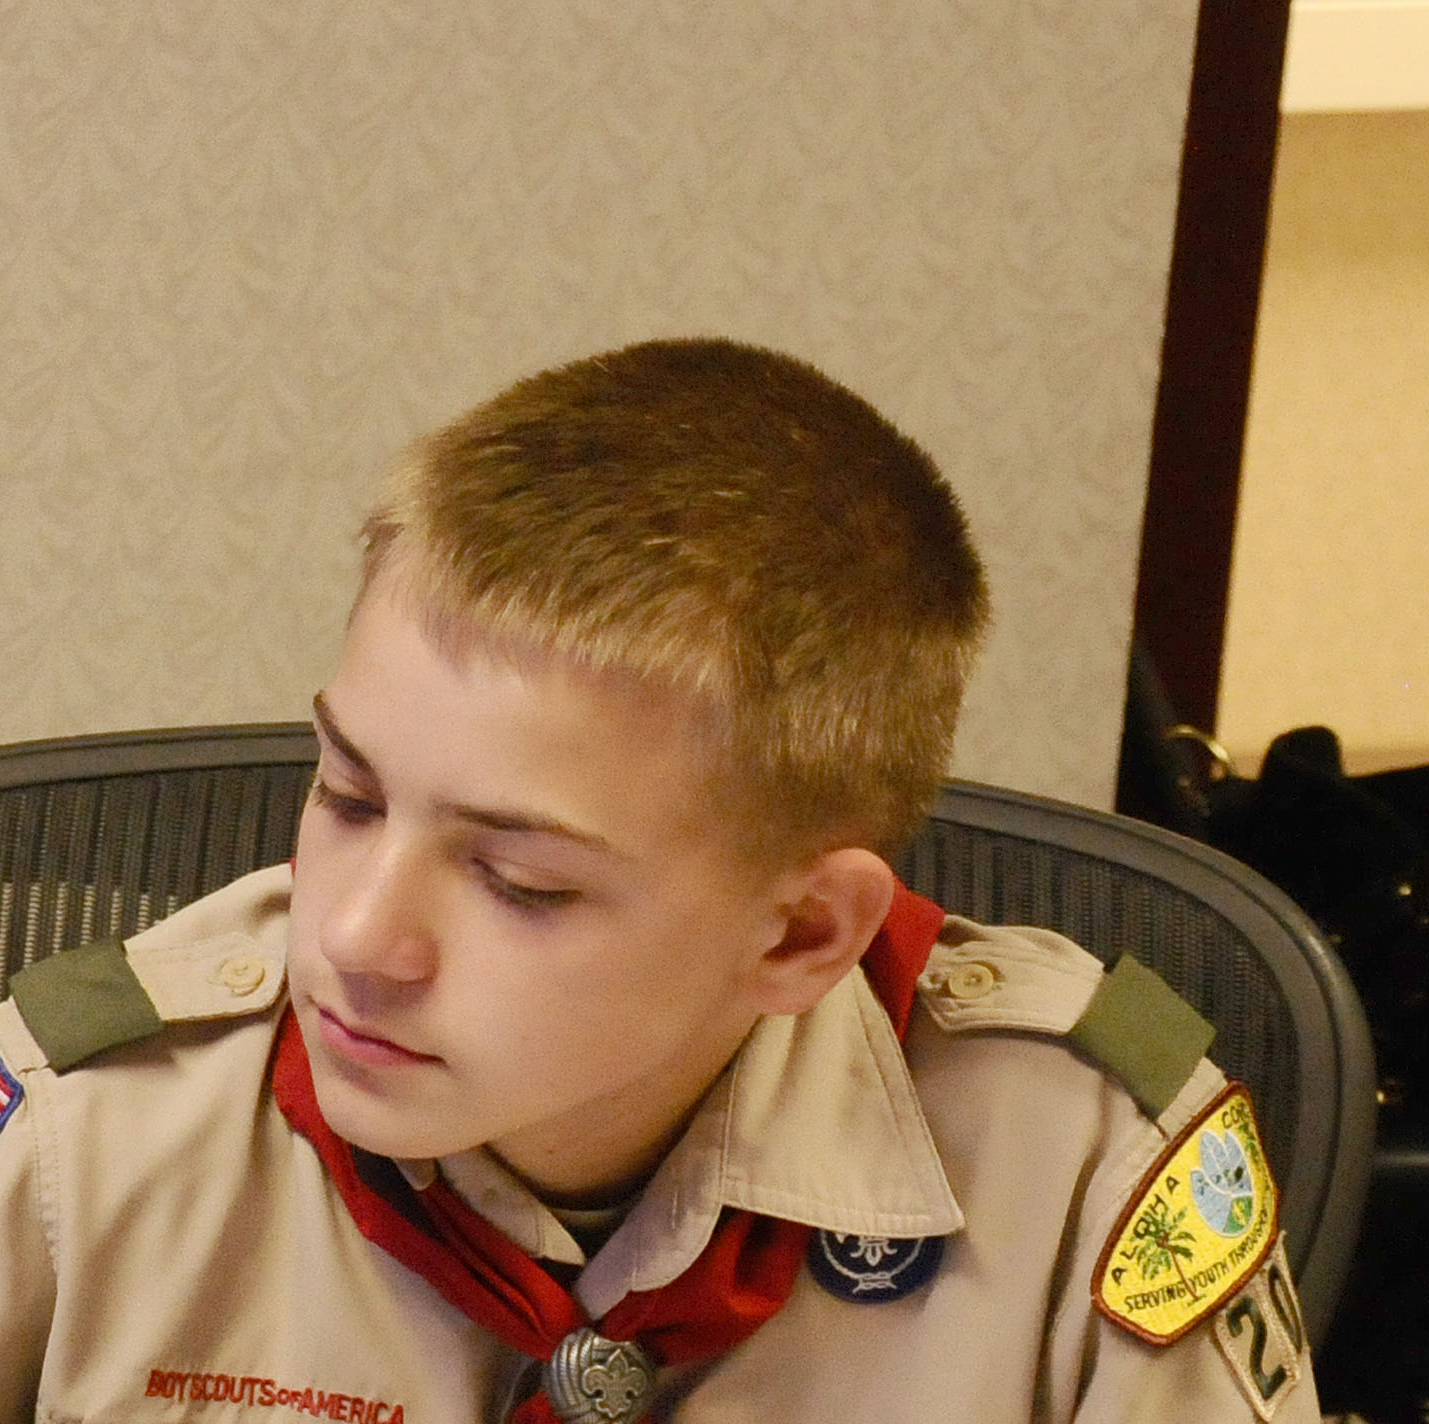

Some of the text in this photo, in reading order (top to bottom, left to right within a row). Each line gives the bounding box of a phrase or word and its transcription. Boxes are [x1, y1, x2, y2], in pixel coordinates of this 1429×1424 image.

[1110, 1174, 1181, 1287] ALOHA
[1124, 1280, 1188, 1314] SERVING
[1187, 1258, 1231, 1294] YOUTH
[191, 1371, 276, 1408] SCOUTS
